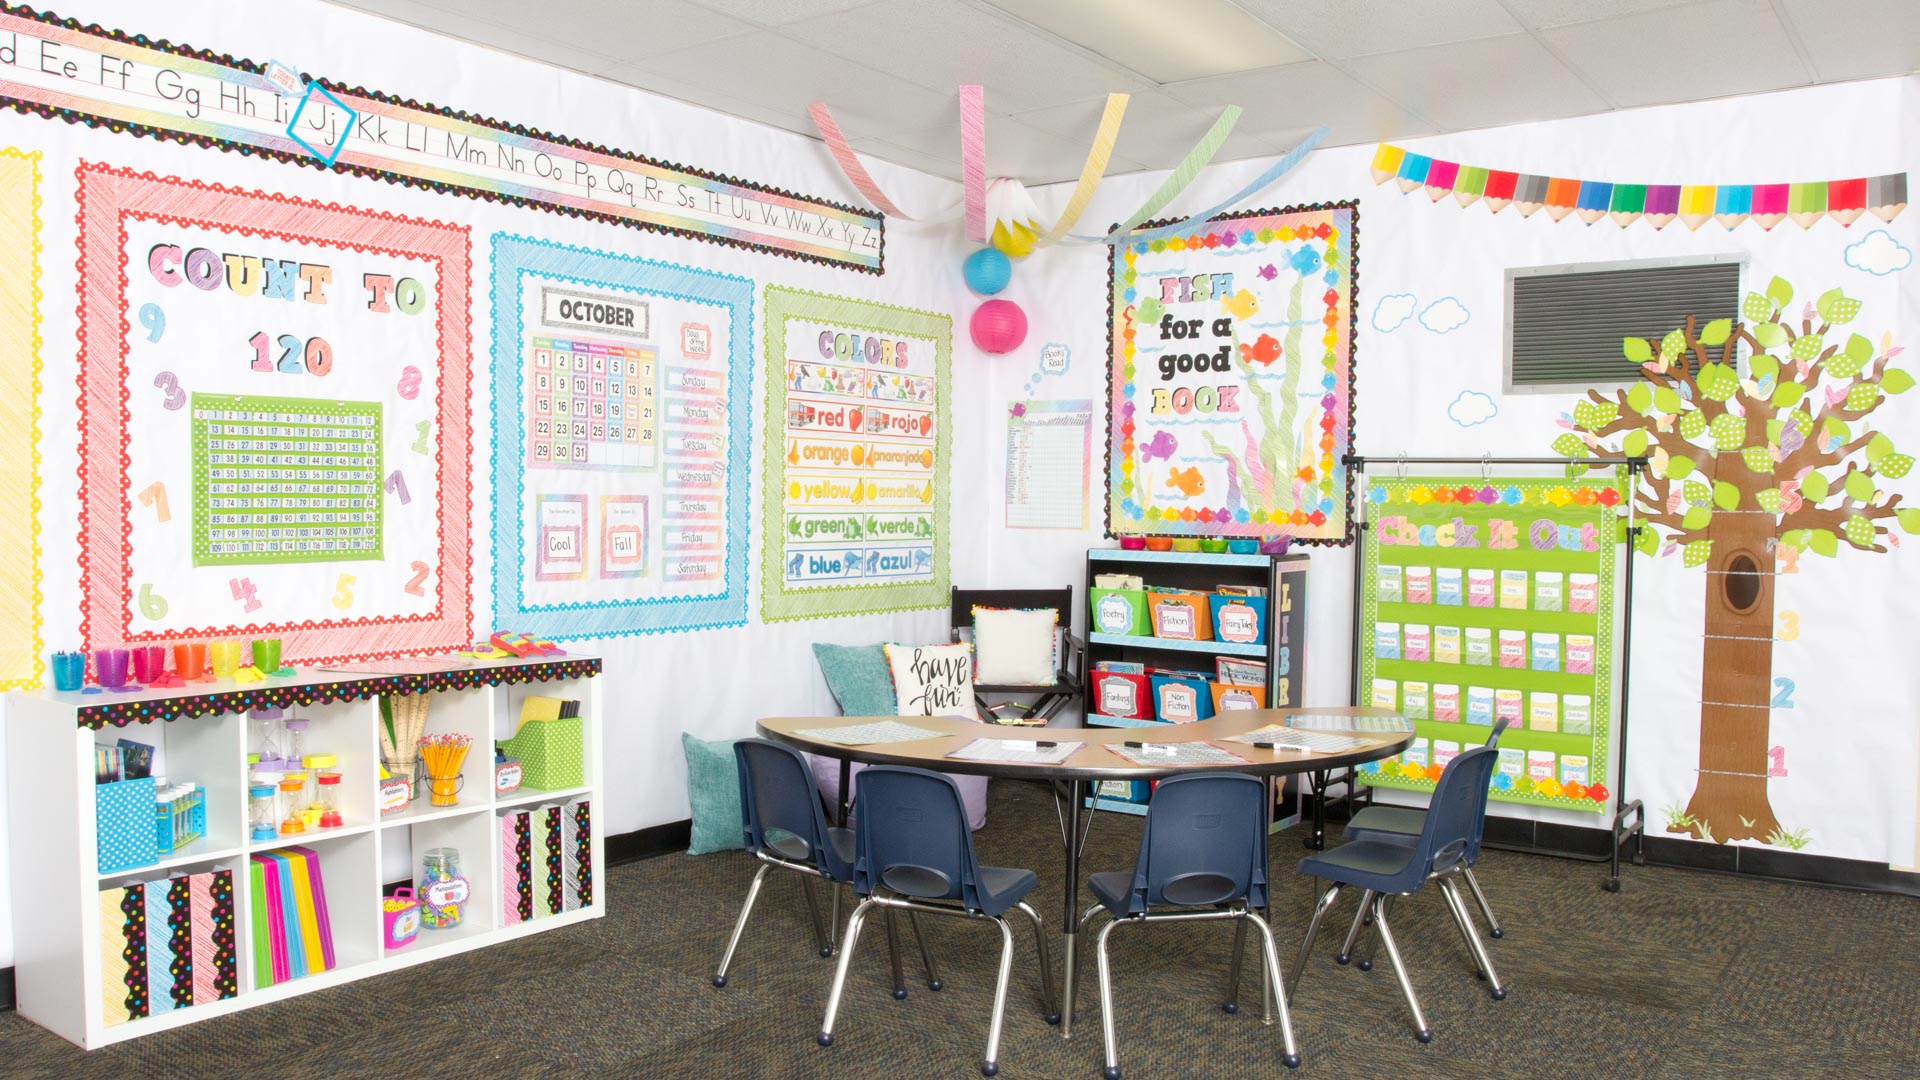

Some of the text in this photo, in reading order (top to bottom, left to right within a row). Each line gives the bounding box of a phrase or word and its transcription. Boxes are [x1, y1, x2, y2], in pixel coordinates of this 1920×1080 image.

[41, 39, 78, 78] Ee
[101, 54, 134, 90] Ff
[155, 69, 200, 119] Gg
[221, 81, 255, 117] Hh
[274, 93, 288, 124] Ii
[309, 105, 335, 145] Jj
[358, 112, 387, 144] Kk
[446, 131, 487, 165] Mm
[498, 144, 525, 173] Nn
[534, 153, 562, 181] Oo
[575, 160, 597, 198] Pp
[607, 169, 636, 207] Qq
[645, 177, 663, 201] Rr
[677, 184, 695, 209] Ss
[704, 189, 720, 214] Tt
[732, 195, 751, 221] Uu
[760, 202, 778, 226] Vv
[785, 208, 811, 233] Ww
[816, 215, 834, 239] Xx
[841, 220, 855, 251] Yy
[862, 226, 877, 248] Zz
[149, 243, 426, 315] COUNT TO
[1160, 273, 1234, 304] FISH
[559, 299, 634, 327] OCTOBER
[139, 303, 166, 344] 9
[1160, 314, 1232, 340] for a
[249, 331, 333, 376] 120
[819, 330, 908, 369] COLORS
[1045, 350, 1065, 359] Books
[542, 355, 650, 376] 1 2 3 4 5 6 7
[1048, 358, 1064, 368] Read
[1158, 346, 1231, 381] good
[153, 371, 186, 411] 3
[397, 365, 422, 400] 8
[540, 377, 652, 397] 8 9 10 11 12 13 14
[681, 374, 706, 390] Sunday
[539, 400, 548, 410] 15
[558, 401, 566, 412] 16
[576, 403, 584, 413] 17
[594, 404, 602, 414] 18
[611, 405, 619, 415] 19
[644, 408, 652, 418] 21
[1151, 385, 1240, 415] BOOK
[683, 407, 708, 422] Monday
[818, 407, 844, 427] red
[891, 414, 919, 434] rojo
[411, 419, 432, 456] 1
[538, 422, 652, 439] 22 23 24 25 26 27 28
[211, 440, 219, 449] 25
[227, 441, 235, 449] 26
[241, 441, 249, 449] 27
[270, 442, 277, 450] 29
[283, 442, 291, 450] 30
[312, 443, 320, 451] 32
[325, 443, 333, 451] 33
[537, 445, 584, 457] 29 30 31
[682, 438, 706, 451] Tuesday
[803, 445, 849, 466] orange
[212, 470, 220, 478] 49
[226, 470, 234, 478] 50
[243, 470, 250, 478] 51
[257, 470, 264, 478] 52
[271, 470, 279, 478] 53
[313, 471, 320, 479] 56
[326, 471, 334, 479] 57
[676, 469, 712, 484] Wednesday
[804, 480, 851, 502] yellow
[879, 484, 920, 498] amarillo
[680, 501, 706, 513] Thursday
[804, 519, 846, 538] green
[879, 517, 915, 534] verde
[1376, 515, 1599, 552] Check It Out
[550, 536, 571, 552] Cool
[614, 536, 632, 550] Fall
[682, 532, 702, 545] Friday
[810, 555, 841, 574] blue
[880, 550, 911, 570] azul
[1777, 542, 1800, 574] 4
[404, 560, 430, 598] 2
[677, 563, 706, 576] Saturday
[229, 577, 262, 613] 4
[330, 572, 357, 610] 5
[139, 583, 168, 620] 6
[1103, 609, 1125, 623] Poetry
[1163, 616, 1188, 626] Fiction
[1226, 619, 1240, 632] Fairy
[1777, 610, 1800, 641] 3
[909, 648, 967, 686] have
[1242, 674, 1265, 683] WOMEN
[909, 684, 960, 716] fun
[1106, 692, 1129, 705] Fantasy
[1771, 677, 1796, 709] 2
[1168, 701, 1189, 711] Fiction
[1767, 746, 1788, 777] 1
